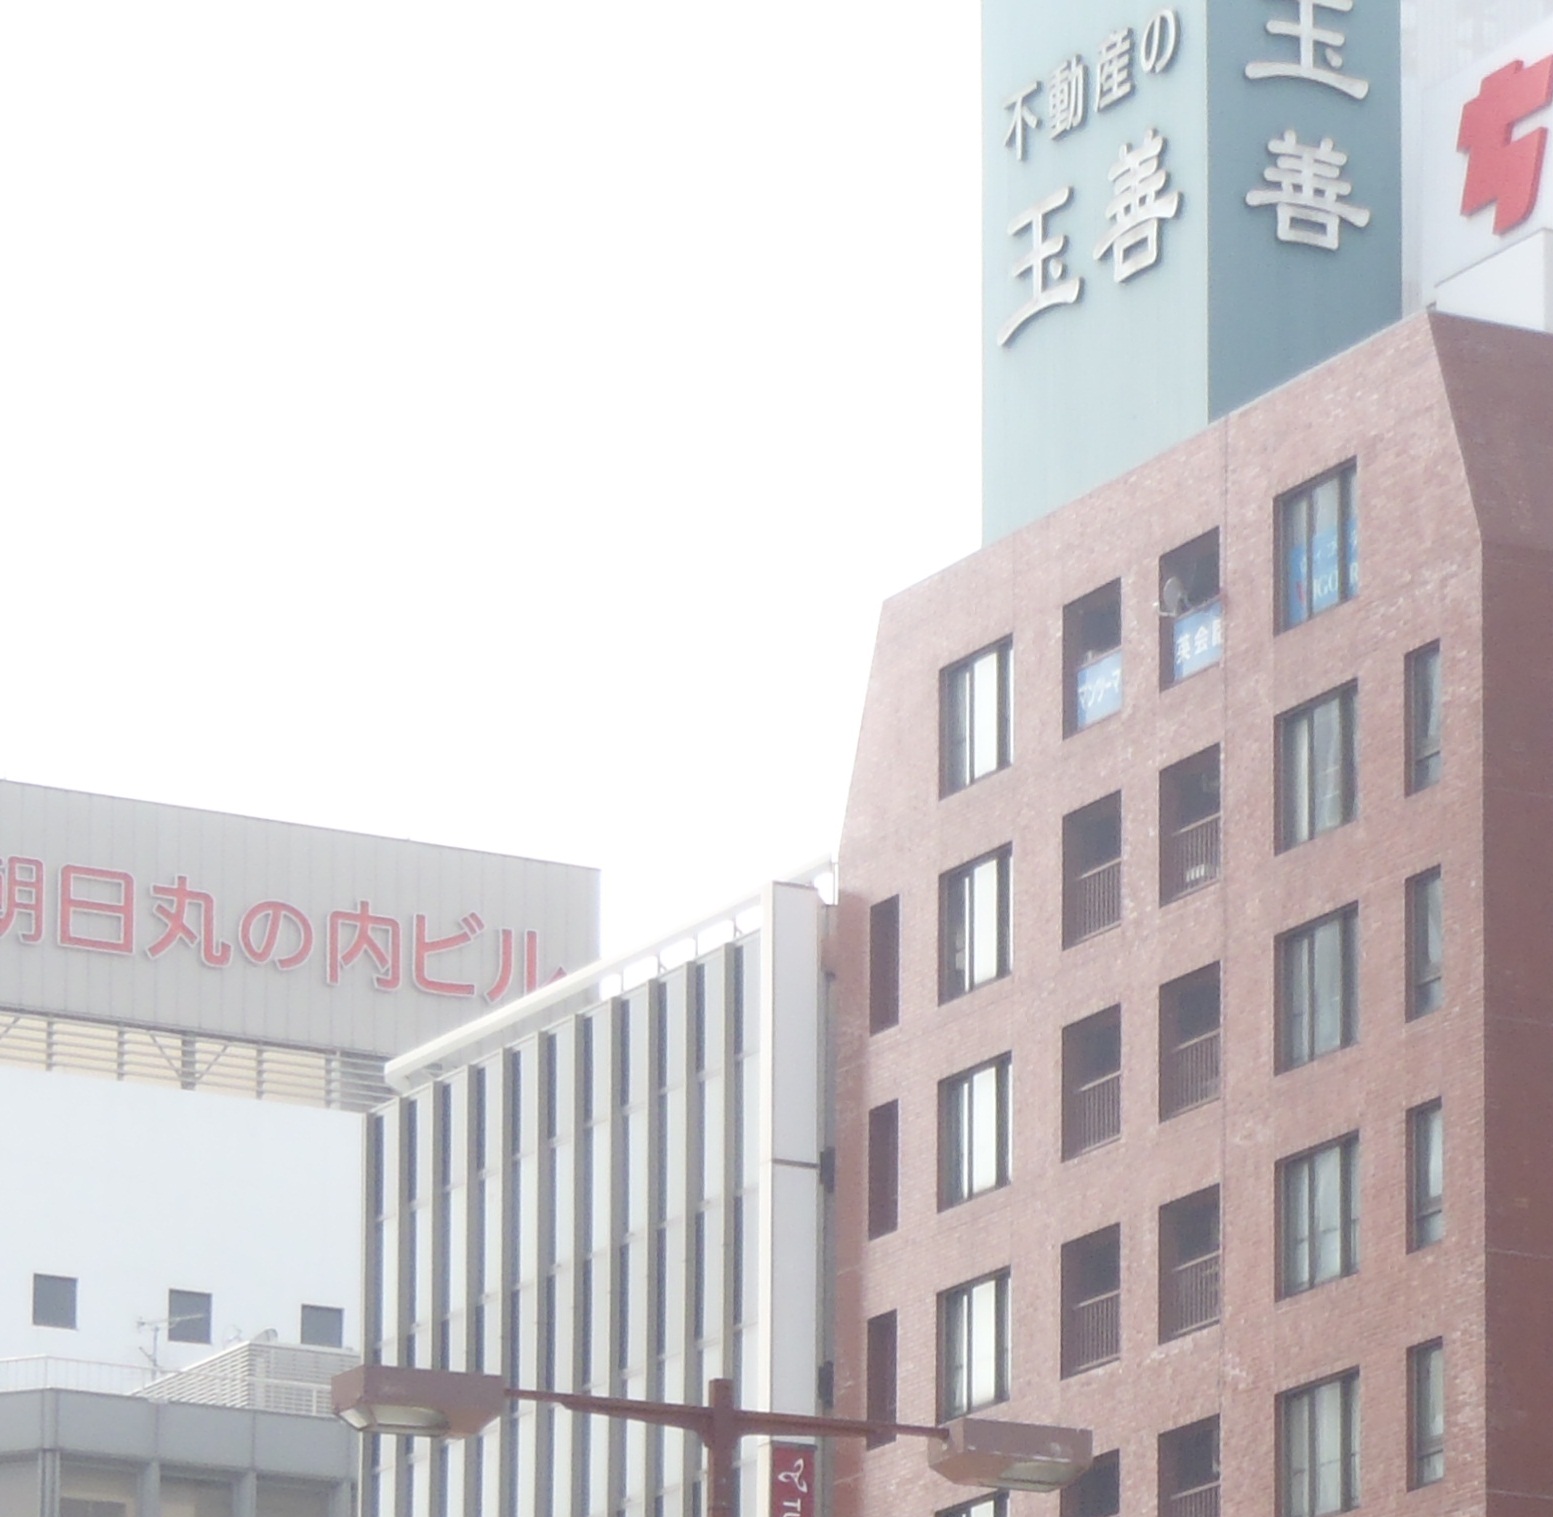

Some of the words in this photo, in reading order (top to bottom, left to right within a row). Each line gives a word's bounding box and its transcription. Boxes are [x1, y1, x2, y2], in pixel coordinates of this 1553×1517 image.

[1003, 6, 1180, 161] 不動産の
[1245, 0, 1371, 251] 玉善
[997, 127, 1184, 347] 玉善
